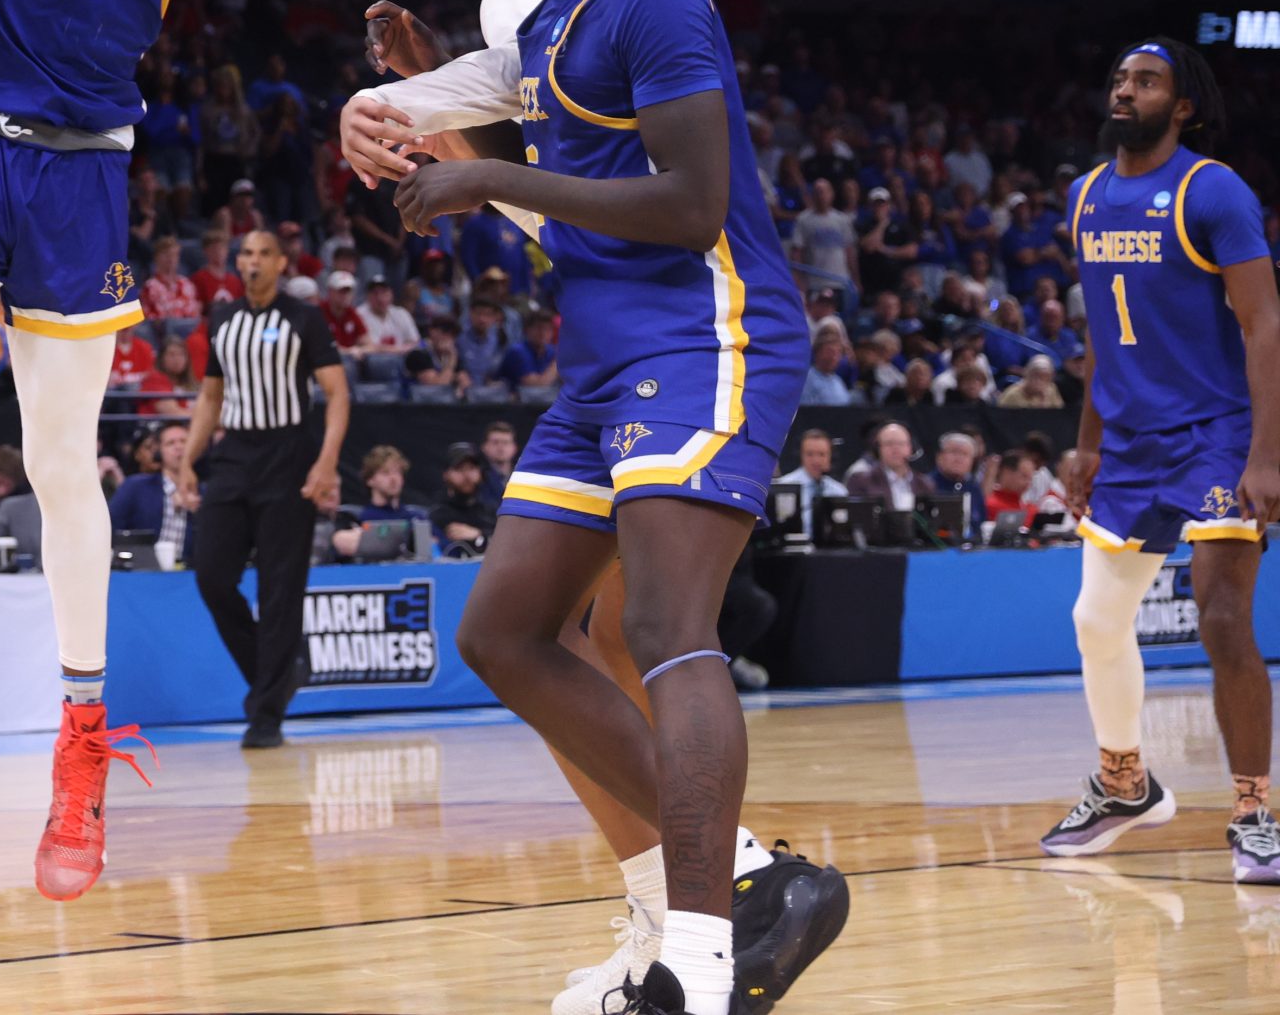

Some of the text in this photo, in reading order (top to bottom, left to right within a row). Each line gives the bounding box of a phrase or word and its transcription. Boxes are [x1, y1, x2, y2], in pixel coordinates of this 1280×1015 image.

[1082, 230, 1163, 263] McNEESE
[1111, 274, 1138, 345] 1
[308, 631, 435, 673] MADNESS
